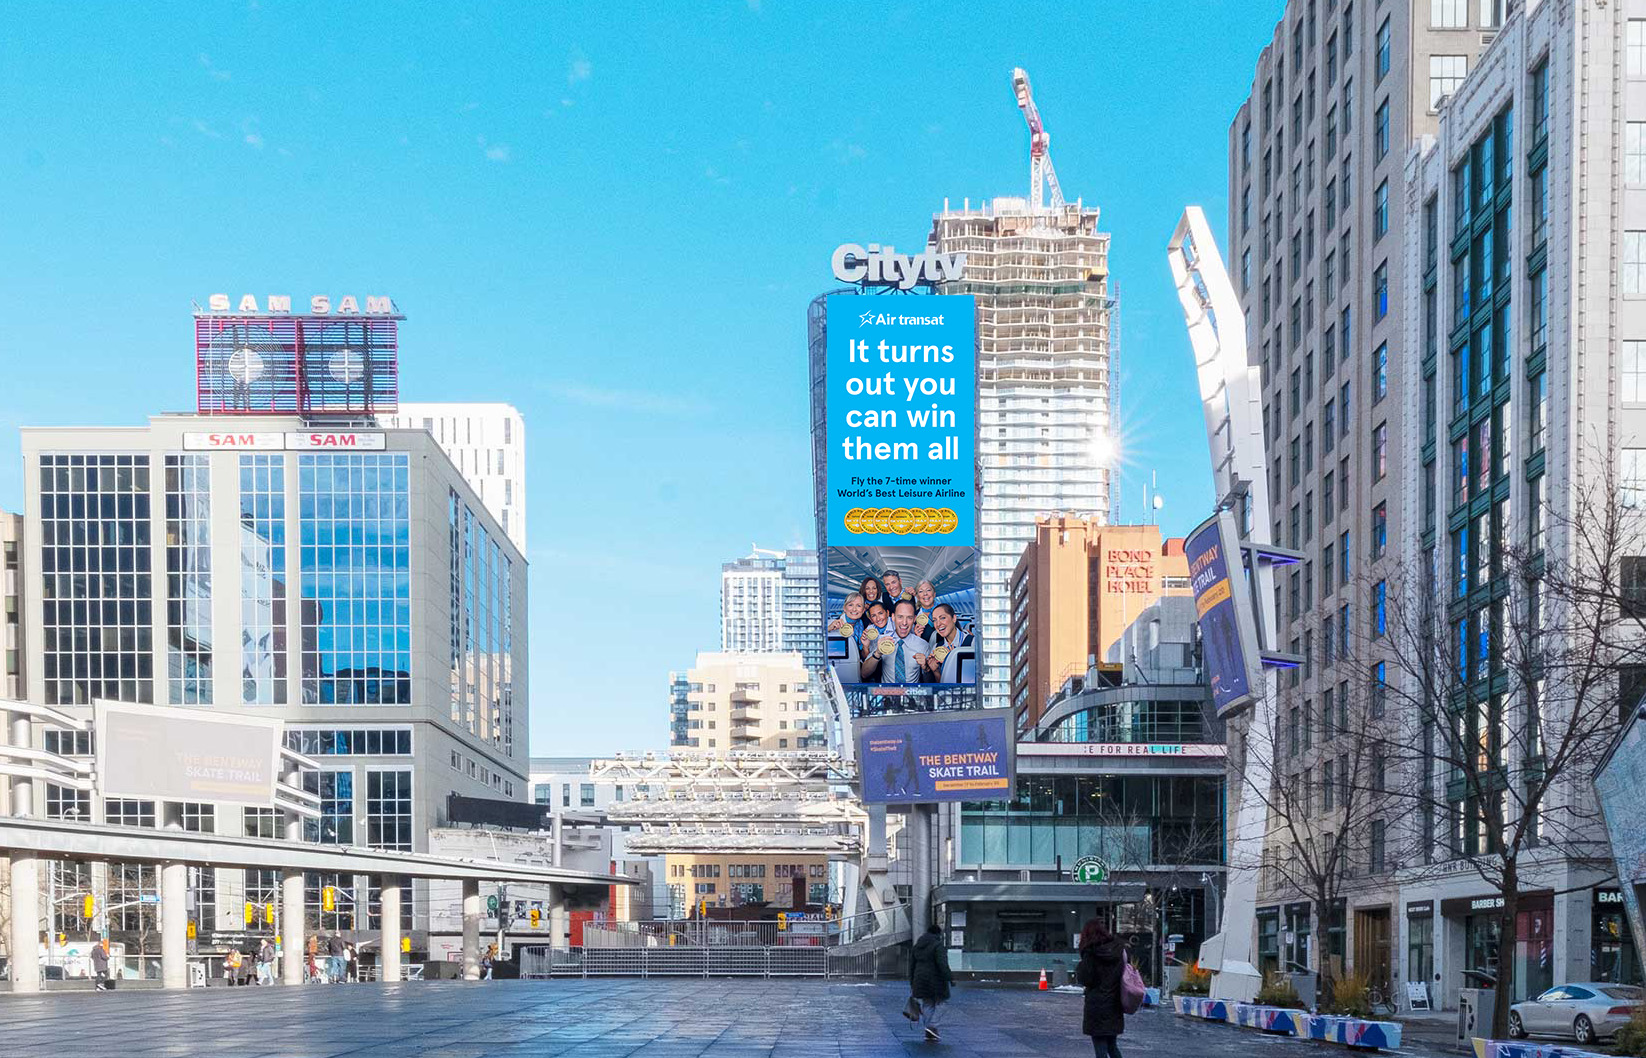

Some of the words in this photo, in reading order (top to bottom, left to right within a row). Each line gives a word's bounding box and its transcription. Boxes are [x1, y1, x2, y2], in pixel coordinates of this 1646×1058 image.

[831, 244, 967, 289] Citytv
[209, 294, 291, 312] SAM
[311, 295, 391, 314] SAM
[875, 314, 897, 325] Air
[898, 315, 945, 325] transat
[849, 339, 870, 362] It
[877, 339, 955, 362] turns
[845, 372, 896, 395] out
[903, 378, 956, 401] you
[845, 410, 897, 427] can
[906, 403, 956, 427] win
[208, 434, 255, 446] SAM
[310, 434, 356, 446] SAM
[841, 436, 919, 460] them
[927, 436, 959, 460] all
[851, 477, 865, 486] Fly
[866, 477, 883, 485] the
[885, 477, 917, 485] 7-time
[919, 477, 952, 485] winner
[875, 489, 896, 497] Best
[898, 489, 933, 497] Leisure
[934, 489, 966, 497] Airline
[1108, 551, 1151, 563] BOND
[1107, 566, 1153, 578] PLACE
[1198, 567, 1217, 591] TRAIL
[1108, 581, 1153, 593] HOTEL
[1101, 745, 1121, 754] FOR
[1127, 745, 1156, 754] REAL
[1163, 745, 1187, 754] LIFE
[919, 755, 941, 766] THE
[944, 752, 998, 765] BENTWAY
[185, 766, 224, 779] SKATE
[228, 770, 262, 782] TRAIL
[929, 766, 964, 778] SKATE
[966, 765, 999, 777] TRAIL
[1460, 856, 1497, 870] BUIDING
[1085, 865, 1099, 880] P
[1472, 899, 1495, 910] BARBER
